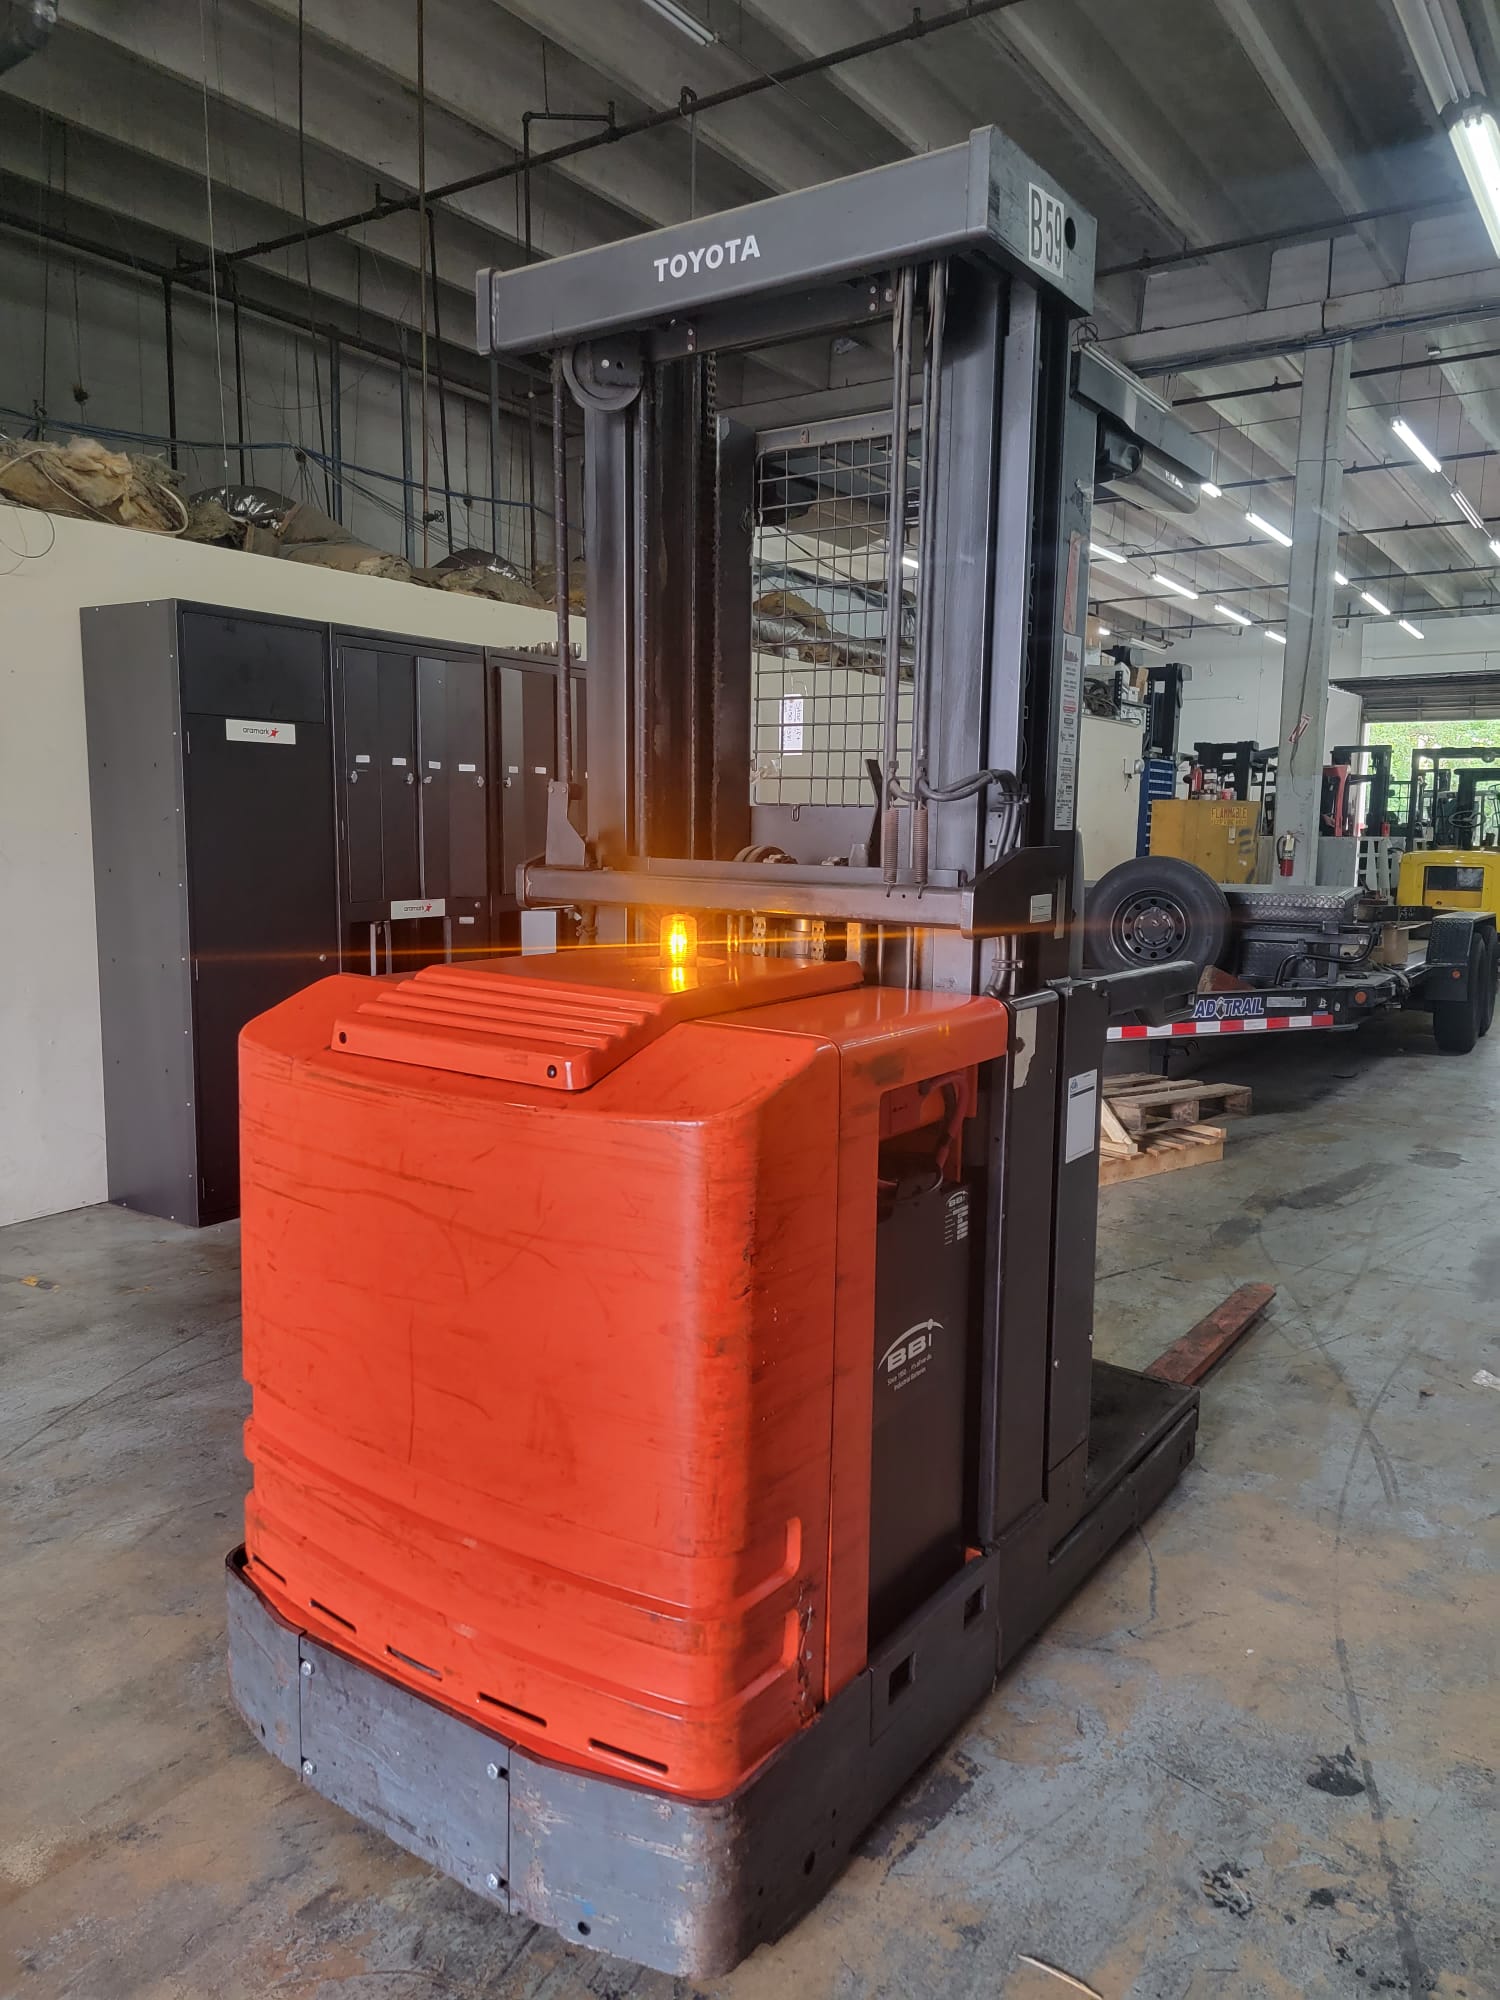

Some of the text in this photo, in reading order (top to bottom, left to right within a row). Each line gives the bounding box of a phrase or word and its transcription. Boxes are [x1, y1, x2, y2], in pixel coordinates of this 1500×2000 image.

[1031, 188, 1062, 270] B59
[653, 234, 761, 282] TOYOTA
[243, 727, 269, 735] aramark
[1192, 999, 1216, 1018] AD
[1222, 997, 1265, 1016] TRAIL
